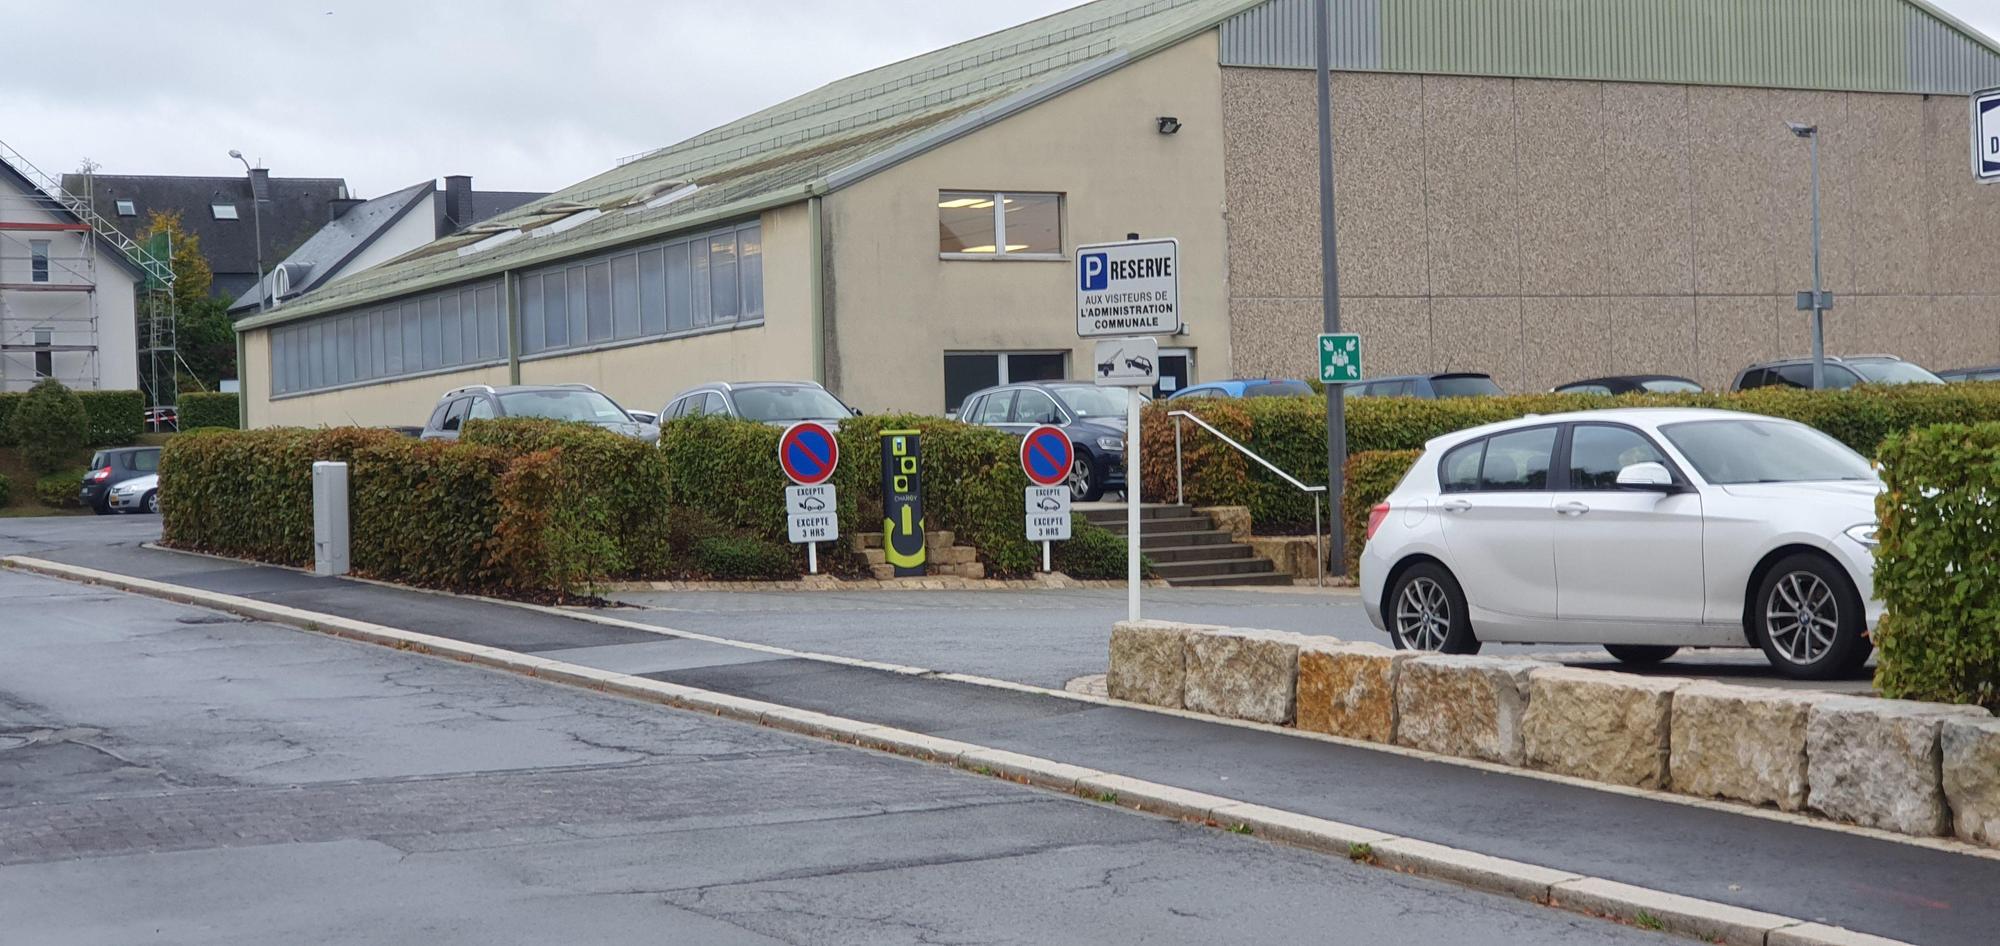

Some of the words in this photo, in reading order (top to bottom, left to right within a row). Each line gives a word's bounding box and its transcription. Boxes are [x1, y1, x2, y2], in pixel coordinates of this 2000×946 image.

[1086, 256, 1102, 288] P
[1111, 257, 1172, 280] RESERVE
[1085, 295, 1103, 305] AUX
[1105, 292, 1152, 304] VISITEURS
[1155, 291, 1167, 301] DE
[1081, 304, 1173, 317] L'ADMINISTRATION
[1095, 317, 1159, 329] COMMUNALE
[797, 487, 824, 496] EXCEPTE
[797, 517, 829, 527] EXCEPTE
[1034, 517, 1063, 526] EXCEPTE
[803, 529, 807, 537] 3
[810, 528, 825, 537] HRS
[1039, 528, 1043, 536] 3
[1045, 527, 1059, 536] HRS
